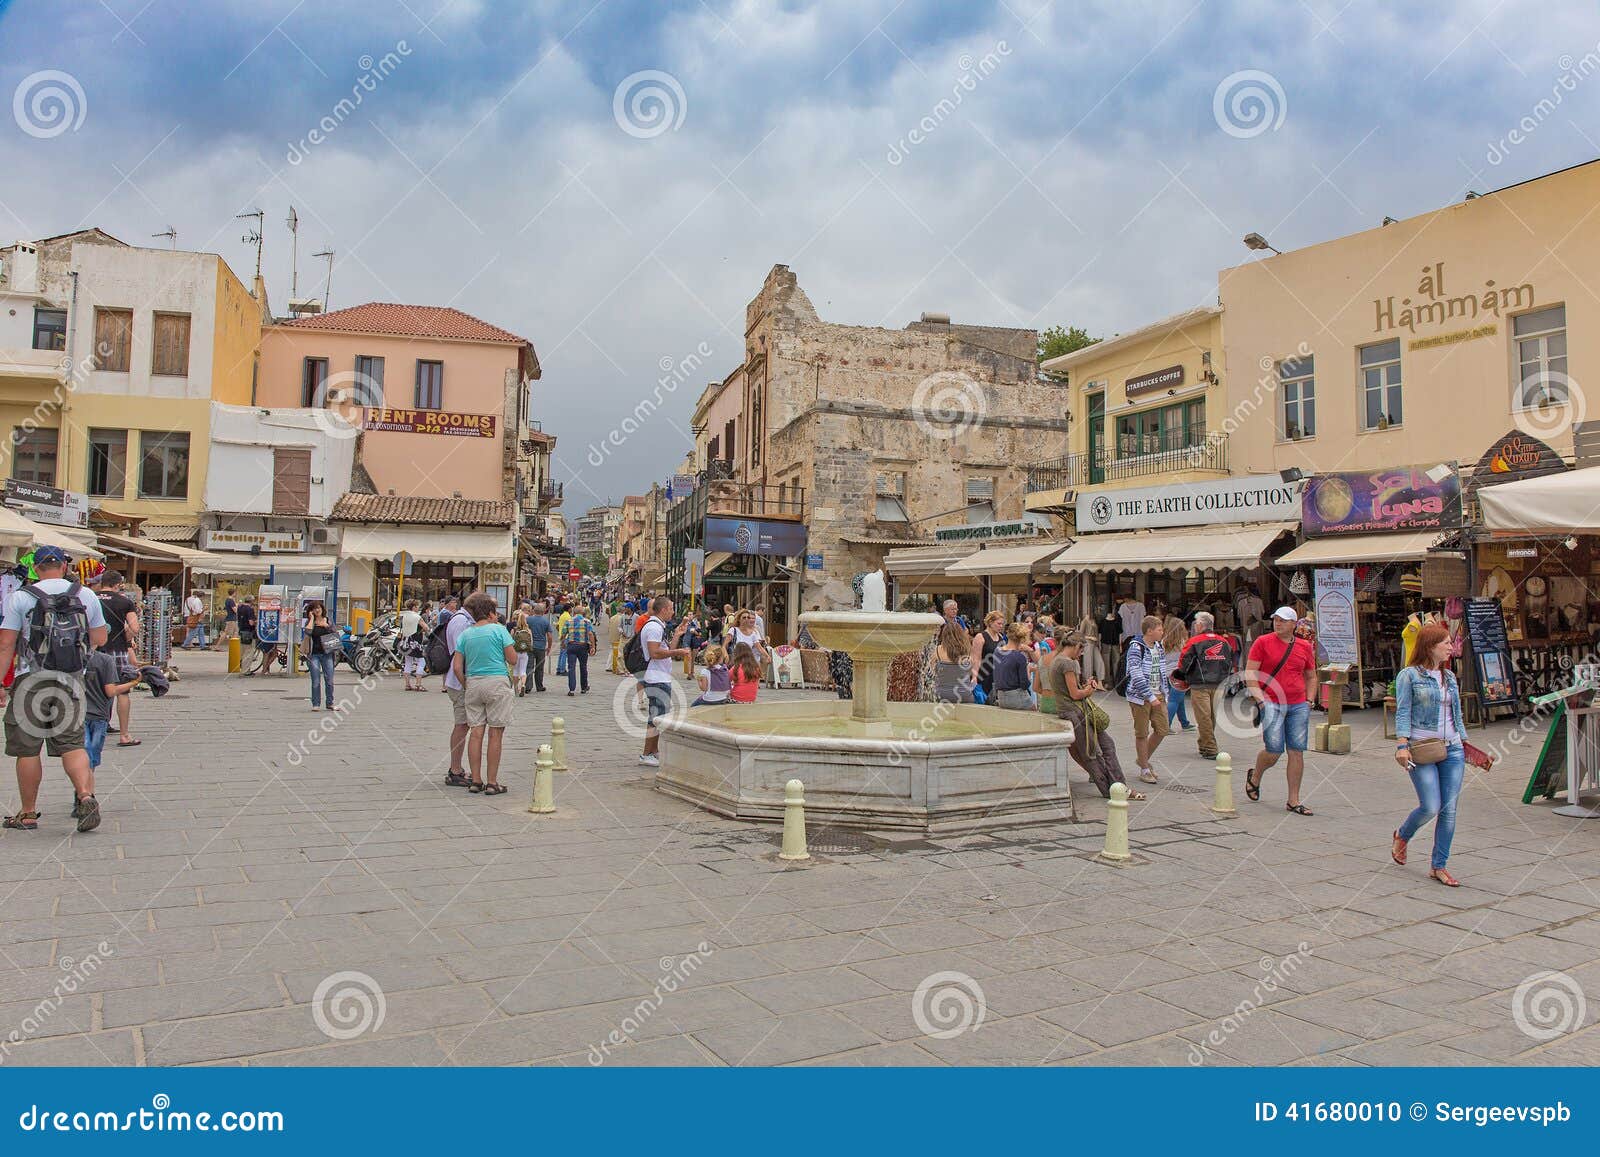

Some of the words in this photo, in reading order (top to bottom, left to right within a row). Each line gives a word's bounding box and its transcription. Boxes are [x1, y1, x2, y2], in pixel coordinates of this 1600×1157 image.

[1373, 280, 1535, 333] Hammam
[1127, 376, 1158, 391] STARBUCKS
[1159, 371, 1181, 383] COFFEE
[367, 408, 417, 424] RENT
[426, 412, 491, 428] ROOMS
[376, 422, 413, 432] CONDITIONED
[16, 486, 31, 496] kapa
[31, 489, 52, 500] change
[1116, 500, 1142, 516] THE
[1146, 496, 1191, 514] EARTH
[1195, 487, 1294, 511] COLLECTION
[935, 526, 992, 541] STARBUCKS
[1508, 549, 1537, 557] entrance
